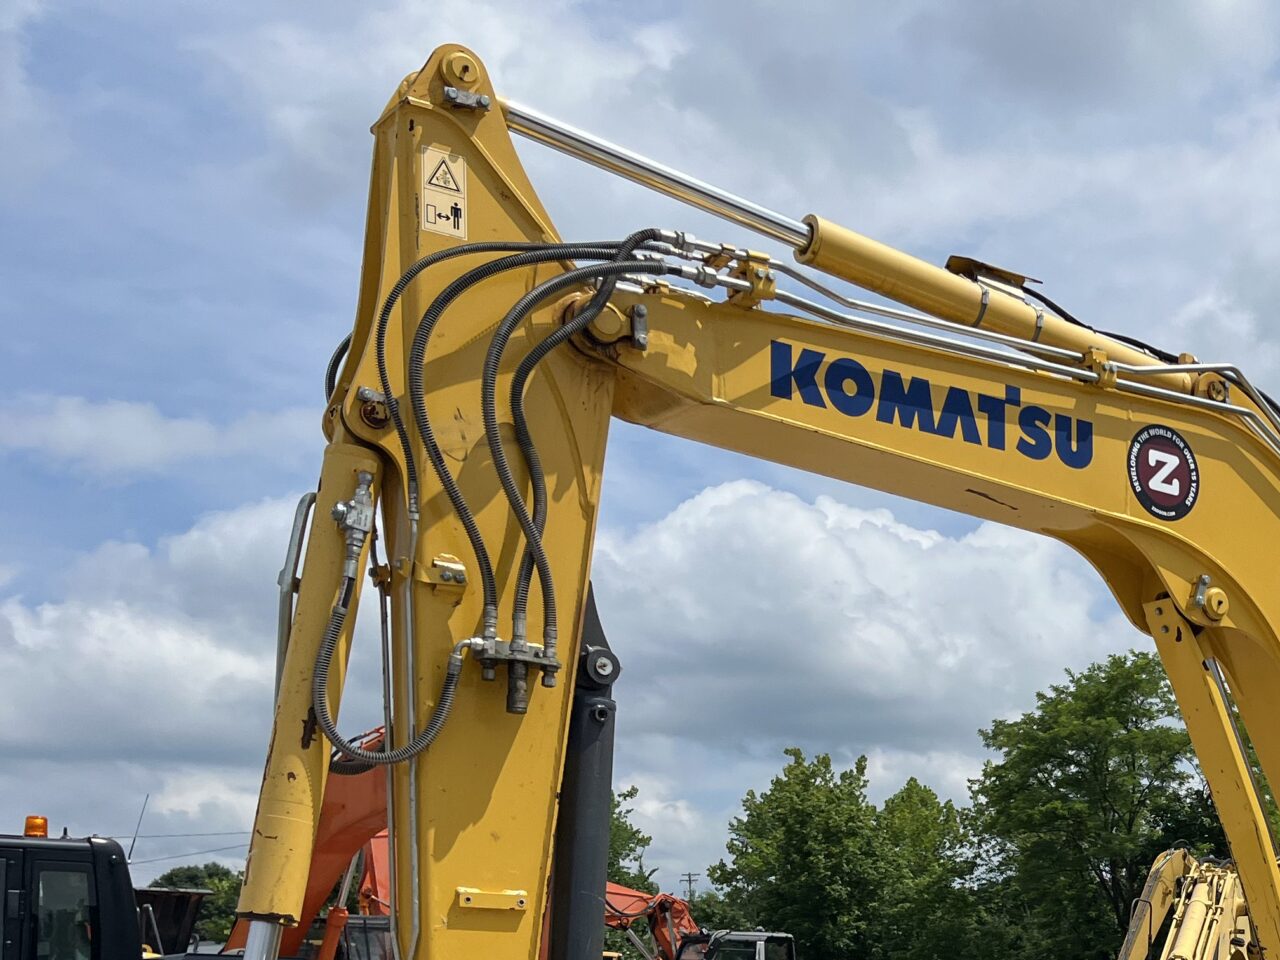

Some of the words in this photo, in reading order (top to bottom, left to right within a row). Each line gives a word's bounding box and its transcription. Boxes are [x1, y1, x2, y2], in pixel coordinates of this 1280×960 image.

[770, 340, 1094, 469] KOMATSU
[1138, 431, 1150, 443] THE
[1149, 428, 1172, 438] WORLD
[1172, 435, 1185, 450] FOR
[1130, 443, 1142, 492] DEVELOPING
[1183, 449, 1195, 469] OVER
[1148, 449, 1180, 496] Z
[1191, 472, 1197, 481] 15
[1185, 482, 1197, 507] YEARS
